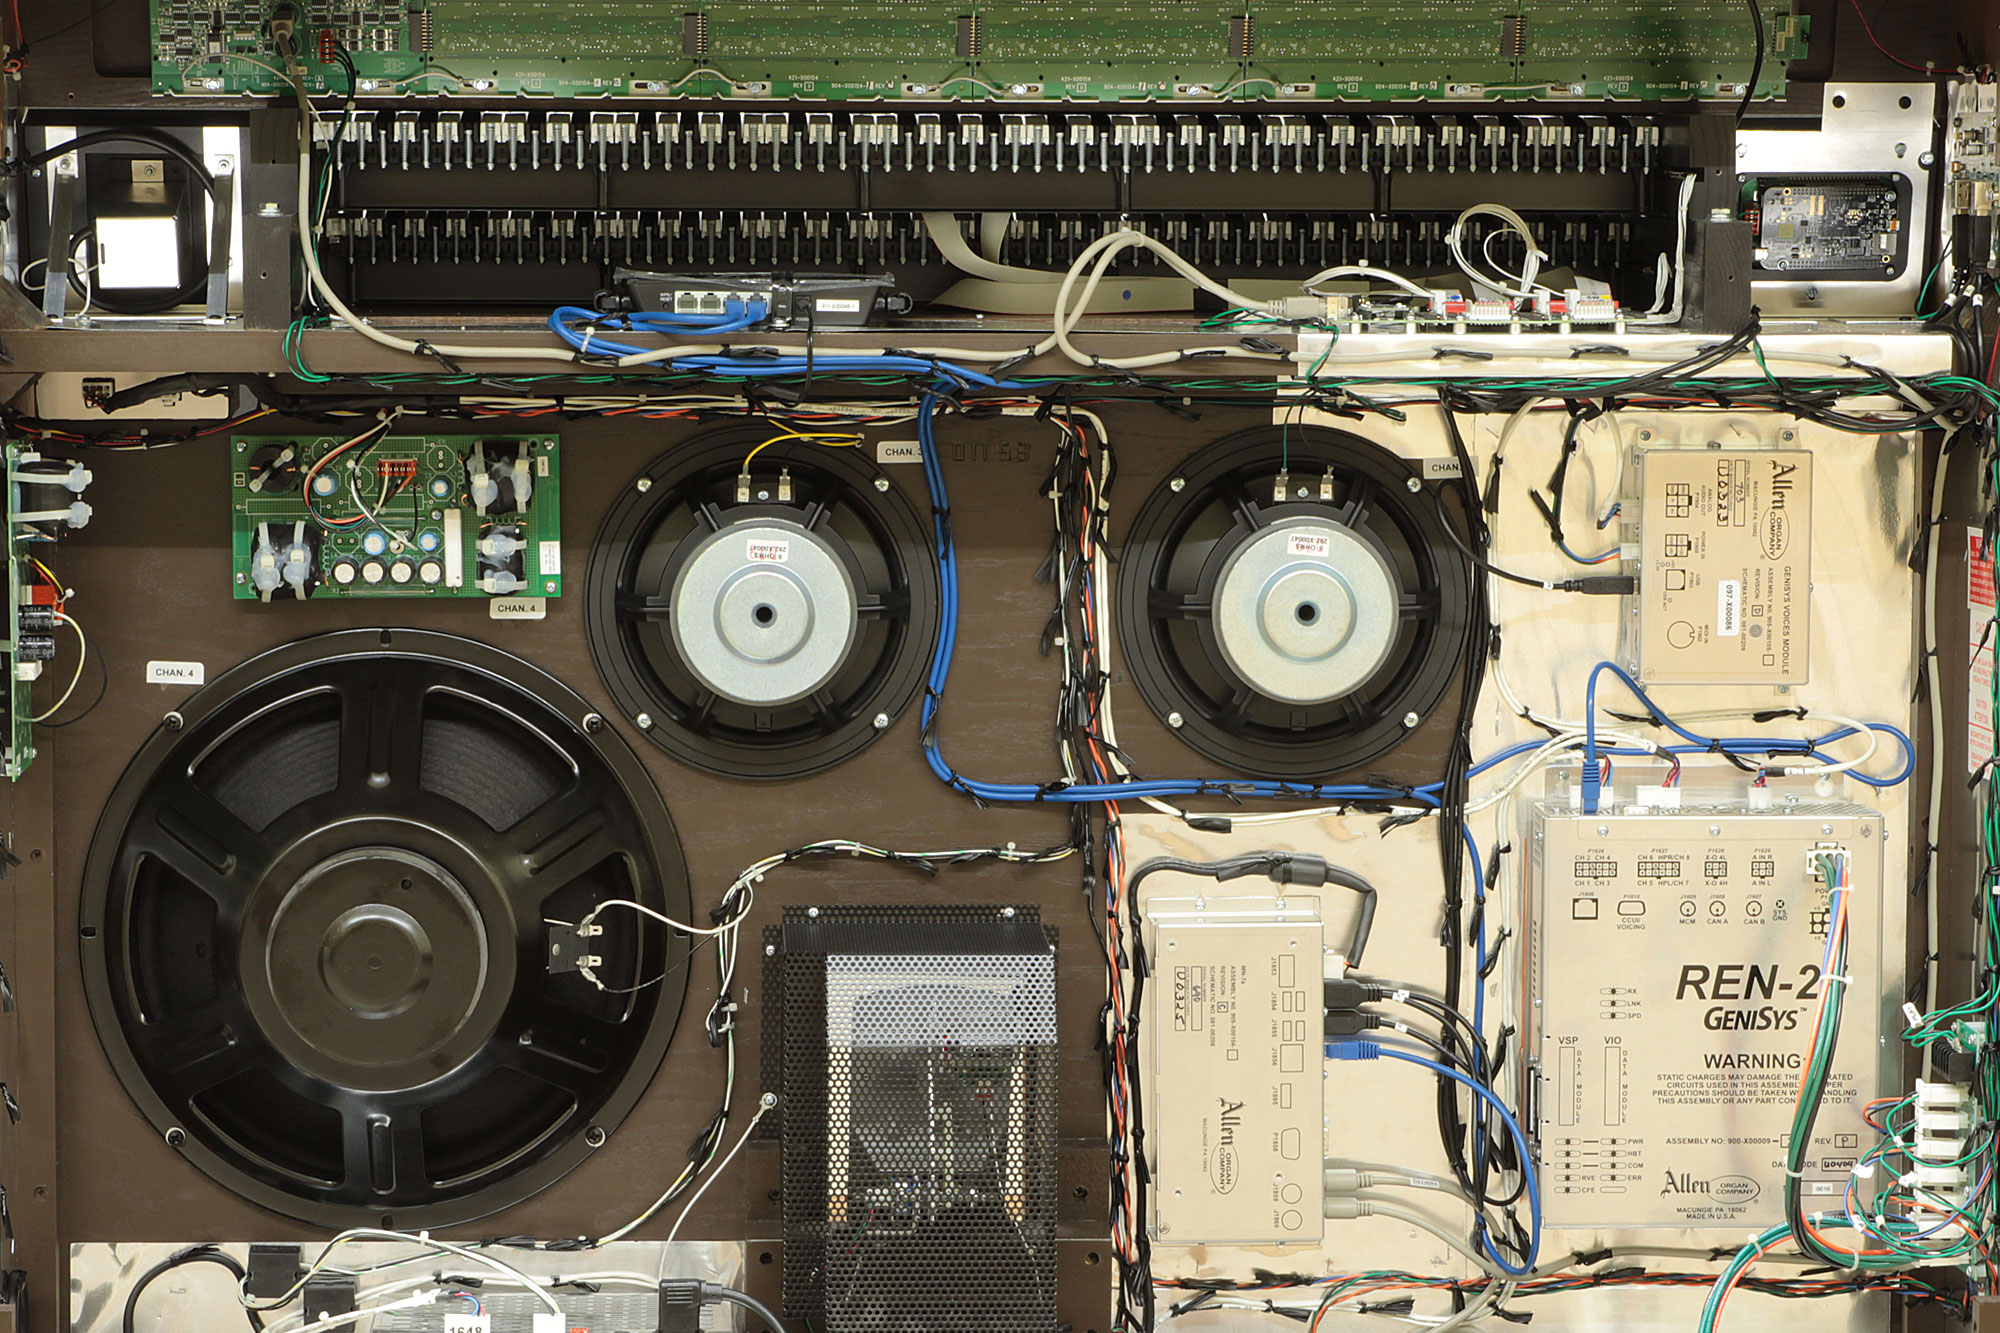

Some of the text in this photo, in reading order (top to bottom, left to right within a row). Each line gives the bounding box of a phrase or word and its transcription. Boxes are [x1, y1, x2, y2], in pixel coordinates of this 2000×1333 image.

[885, 448, 915, 456] CHAN.
[1768, 459, 1799, 510] Allen
[498, 604, 527, 612] CHAN.
[1725, 584, 1733, 630] 097-X00086
[1782, 566, 1791, 675] GENISYS VOICES MODULE
[156, 668, 185, 677] CHAN.
[1676, 965, 1848, 1000] REN-2
[1215, 1097, 1247, 1146] Allen
[1660, 1166, 1710, 1200] Allen
